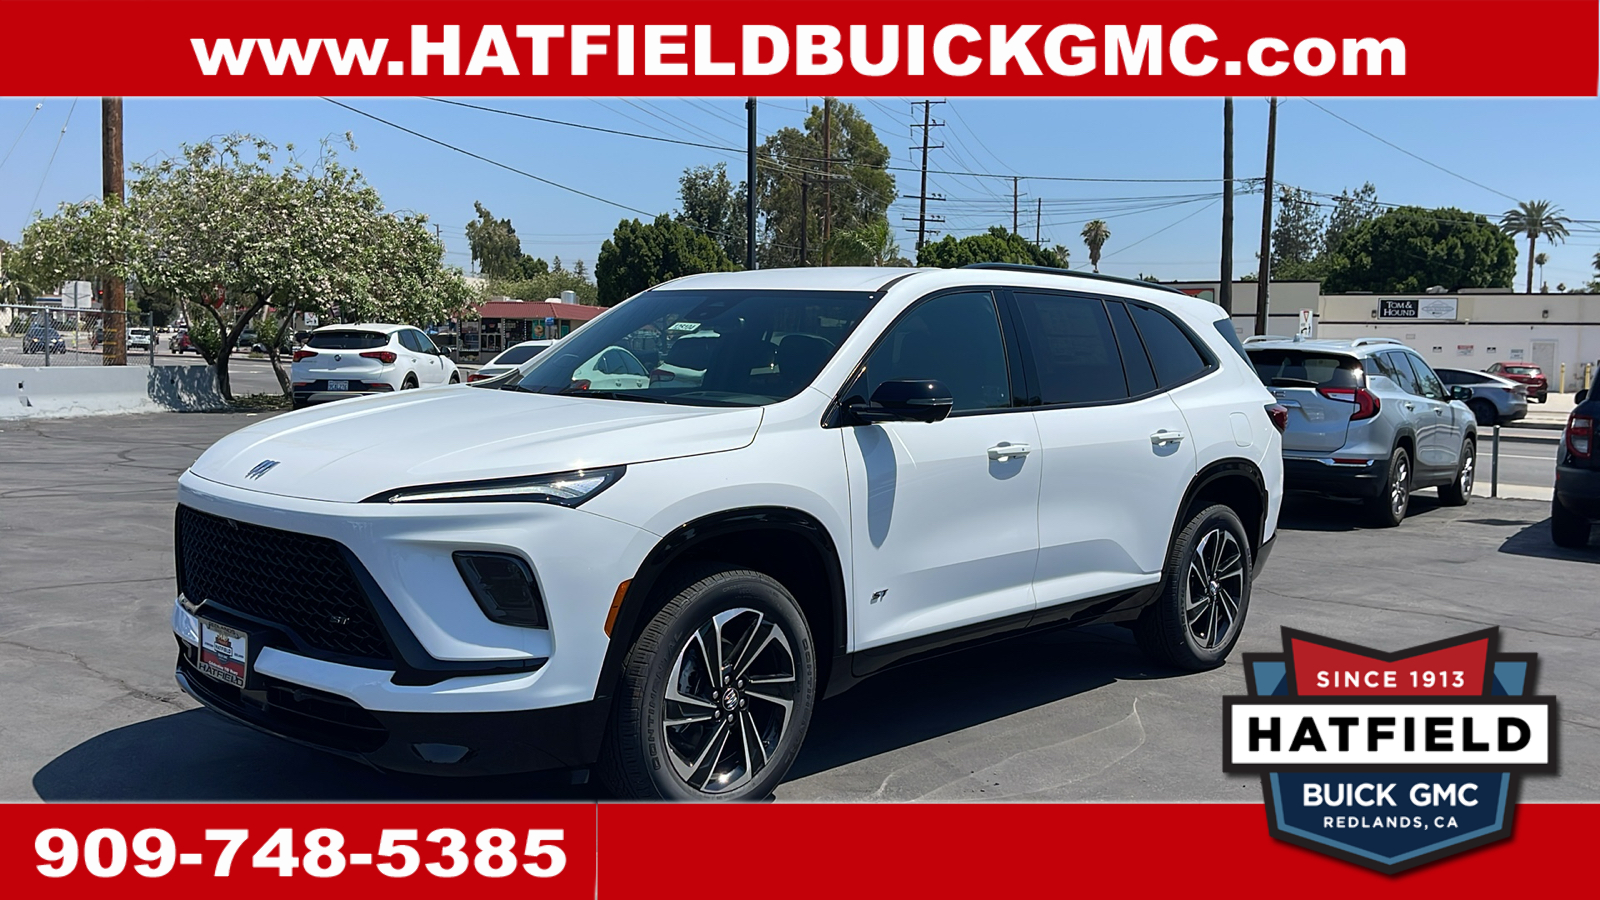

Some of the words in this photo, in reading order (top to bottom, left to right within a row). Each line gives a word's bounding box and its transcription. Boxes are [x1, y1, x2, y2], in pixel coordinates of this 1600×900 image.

[1386, 301, 1405, 309] TOM
[1383, 309, 1415, 317] HOUND
[199, 662, 244, 687] HATFIELD
